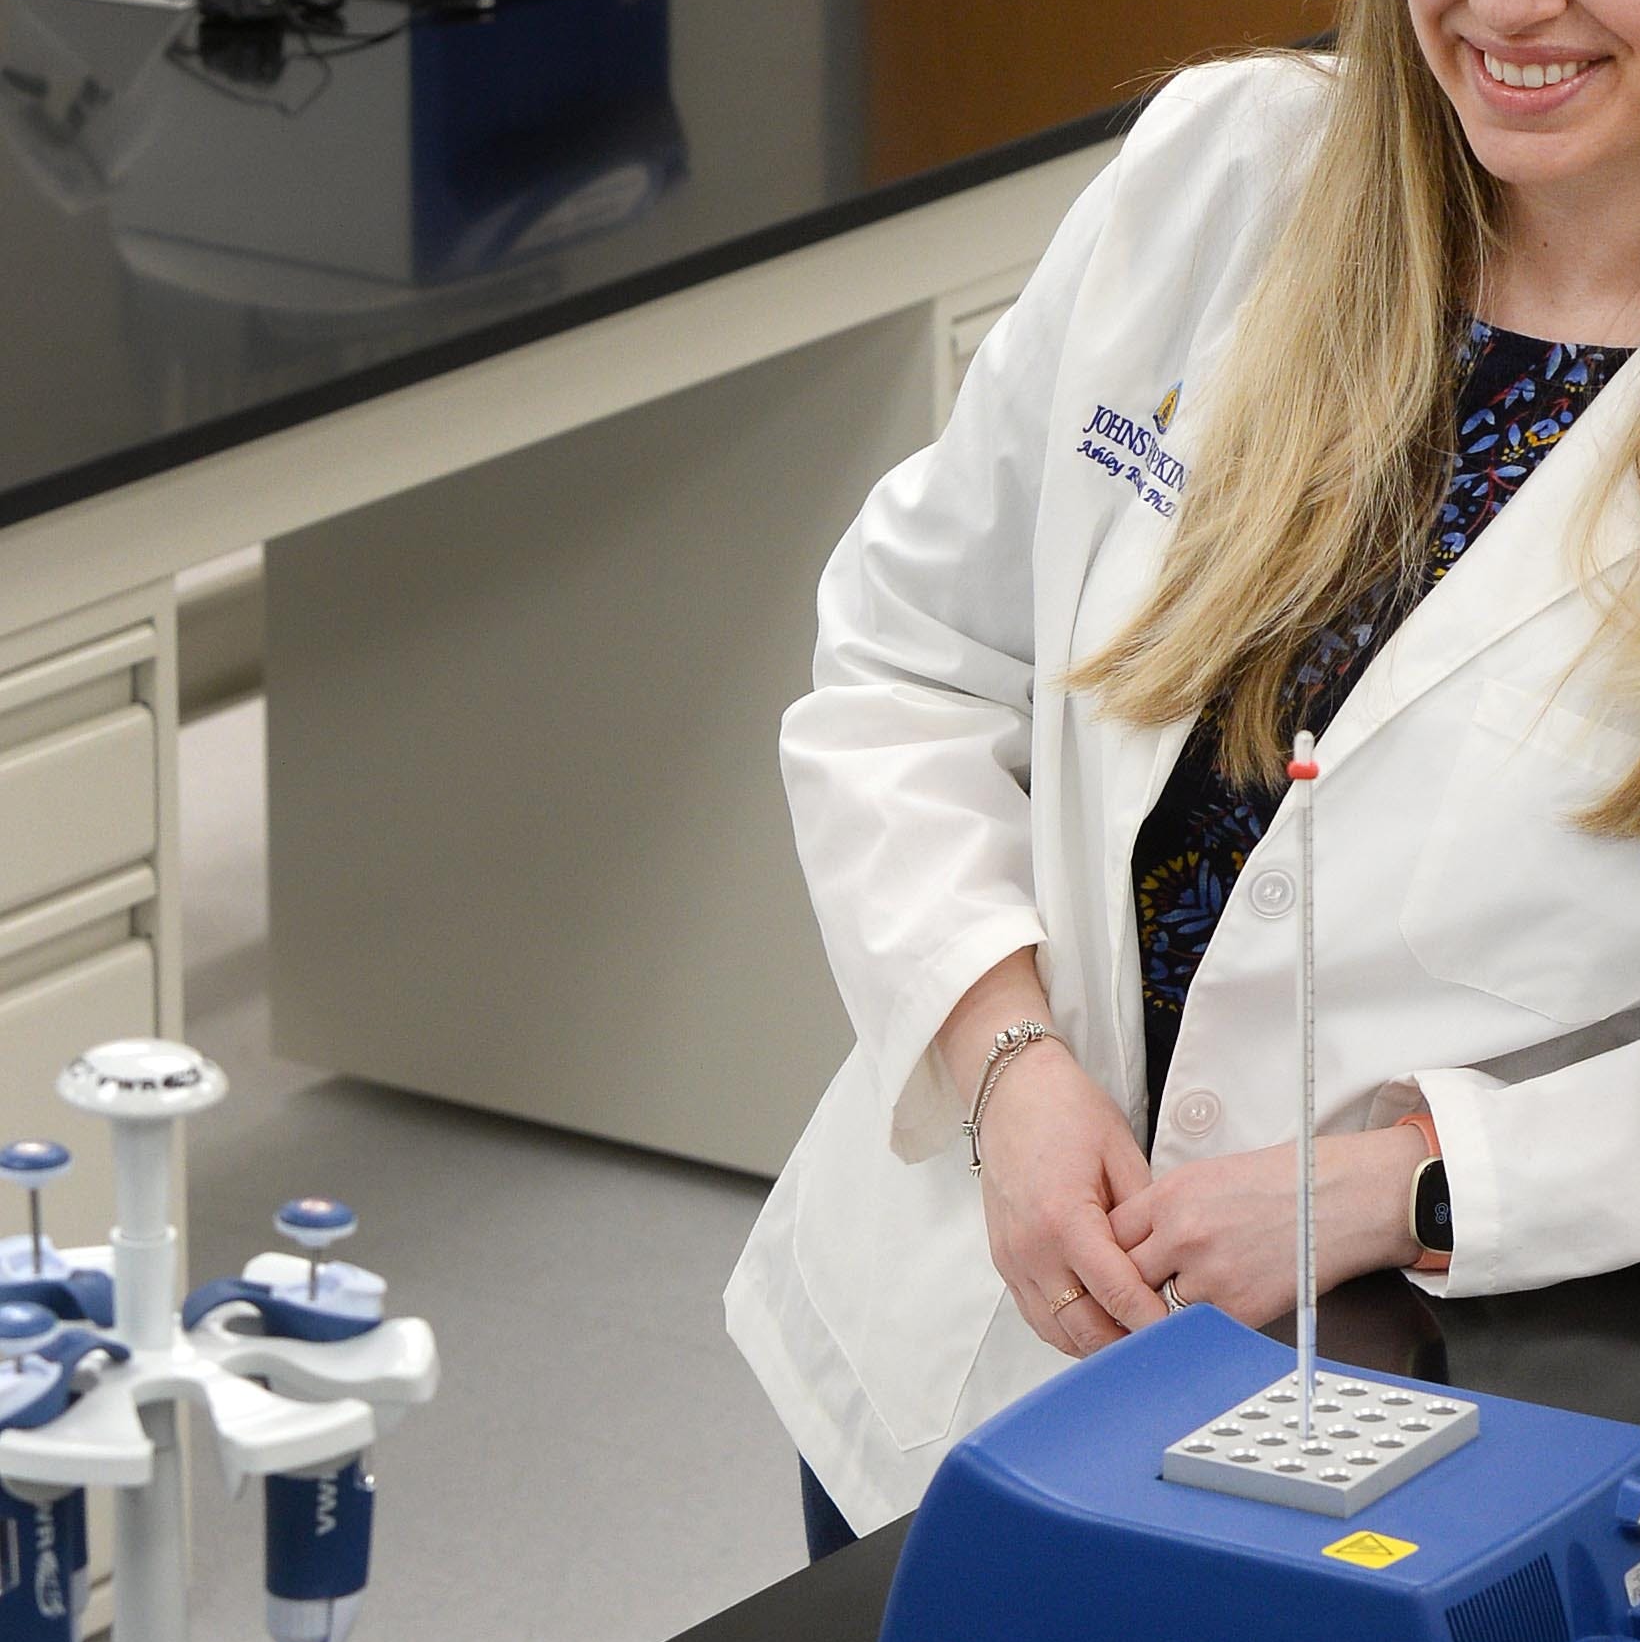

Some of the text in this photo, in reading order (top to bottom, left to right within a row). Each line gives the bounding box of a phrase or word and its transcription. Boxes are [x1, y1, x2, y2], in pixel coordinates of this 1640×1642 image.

[1082, 404, 1152, 457] JOHNS
[1076, 440, 1126, 477] Ashley
[315, 1477, 338, 1537] VW
